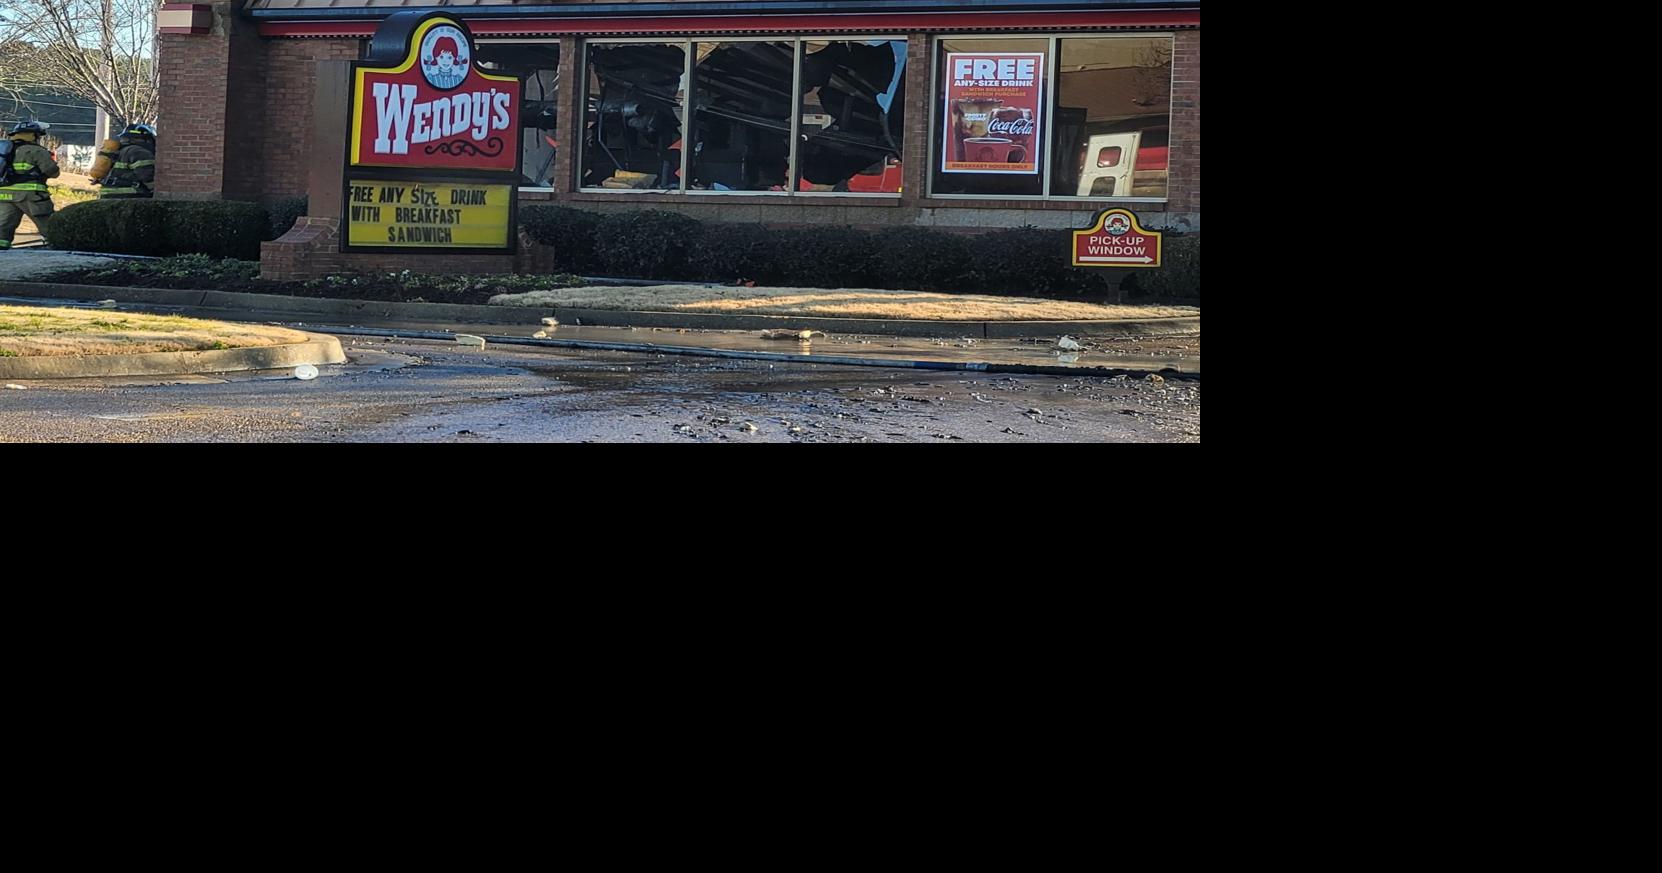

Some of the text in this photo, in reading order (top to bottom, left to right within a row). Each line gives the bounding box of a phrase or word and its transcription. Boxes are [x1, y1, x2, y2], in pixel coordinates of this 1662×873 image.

[954, 58, 1035, 80] FREE
[350, 186, 488, 206] FREE ANY SIZE DRINK
[351, 206, 462, 225] WITH BREAKFAST
[387, 226, 452, 243] SANDWICH
[1089, 236, 1144, 246] PICK-UP
[1088, 246, 1146, 255] WINDOW
